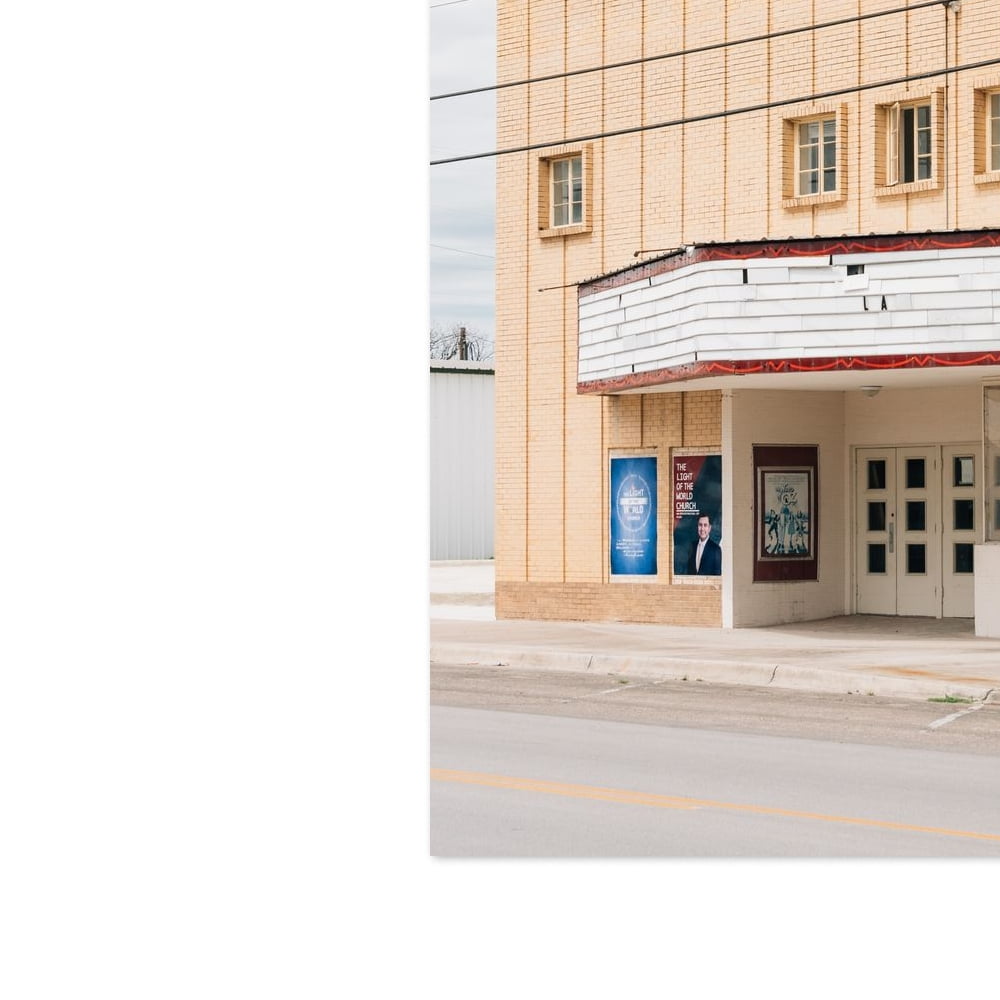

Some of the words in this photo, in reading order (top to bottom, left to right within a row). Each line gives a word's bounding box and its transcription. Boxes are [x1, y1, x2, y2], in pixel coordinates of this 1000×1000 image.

[676, 463, 687, 471] THE
[676, 473, 693, 481] LIGHT
[676, 482, 683, 490] OF
[684, 482, 694, 491] THE
[676, 492, 693, 500] WORLD
